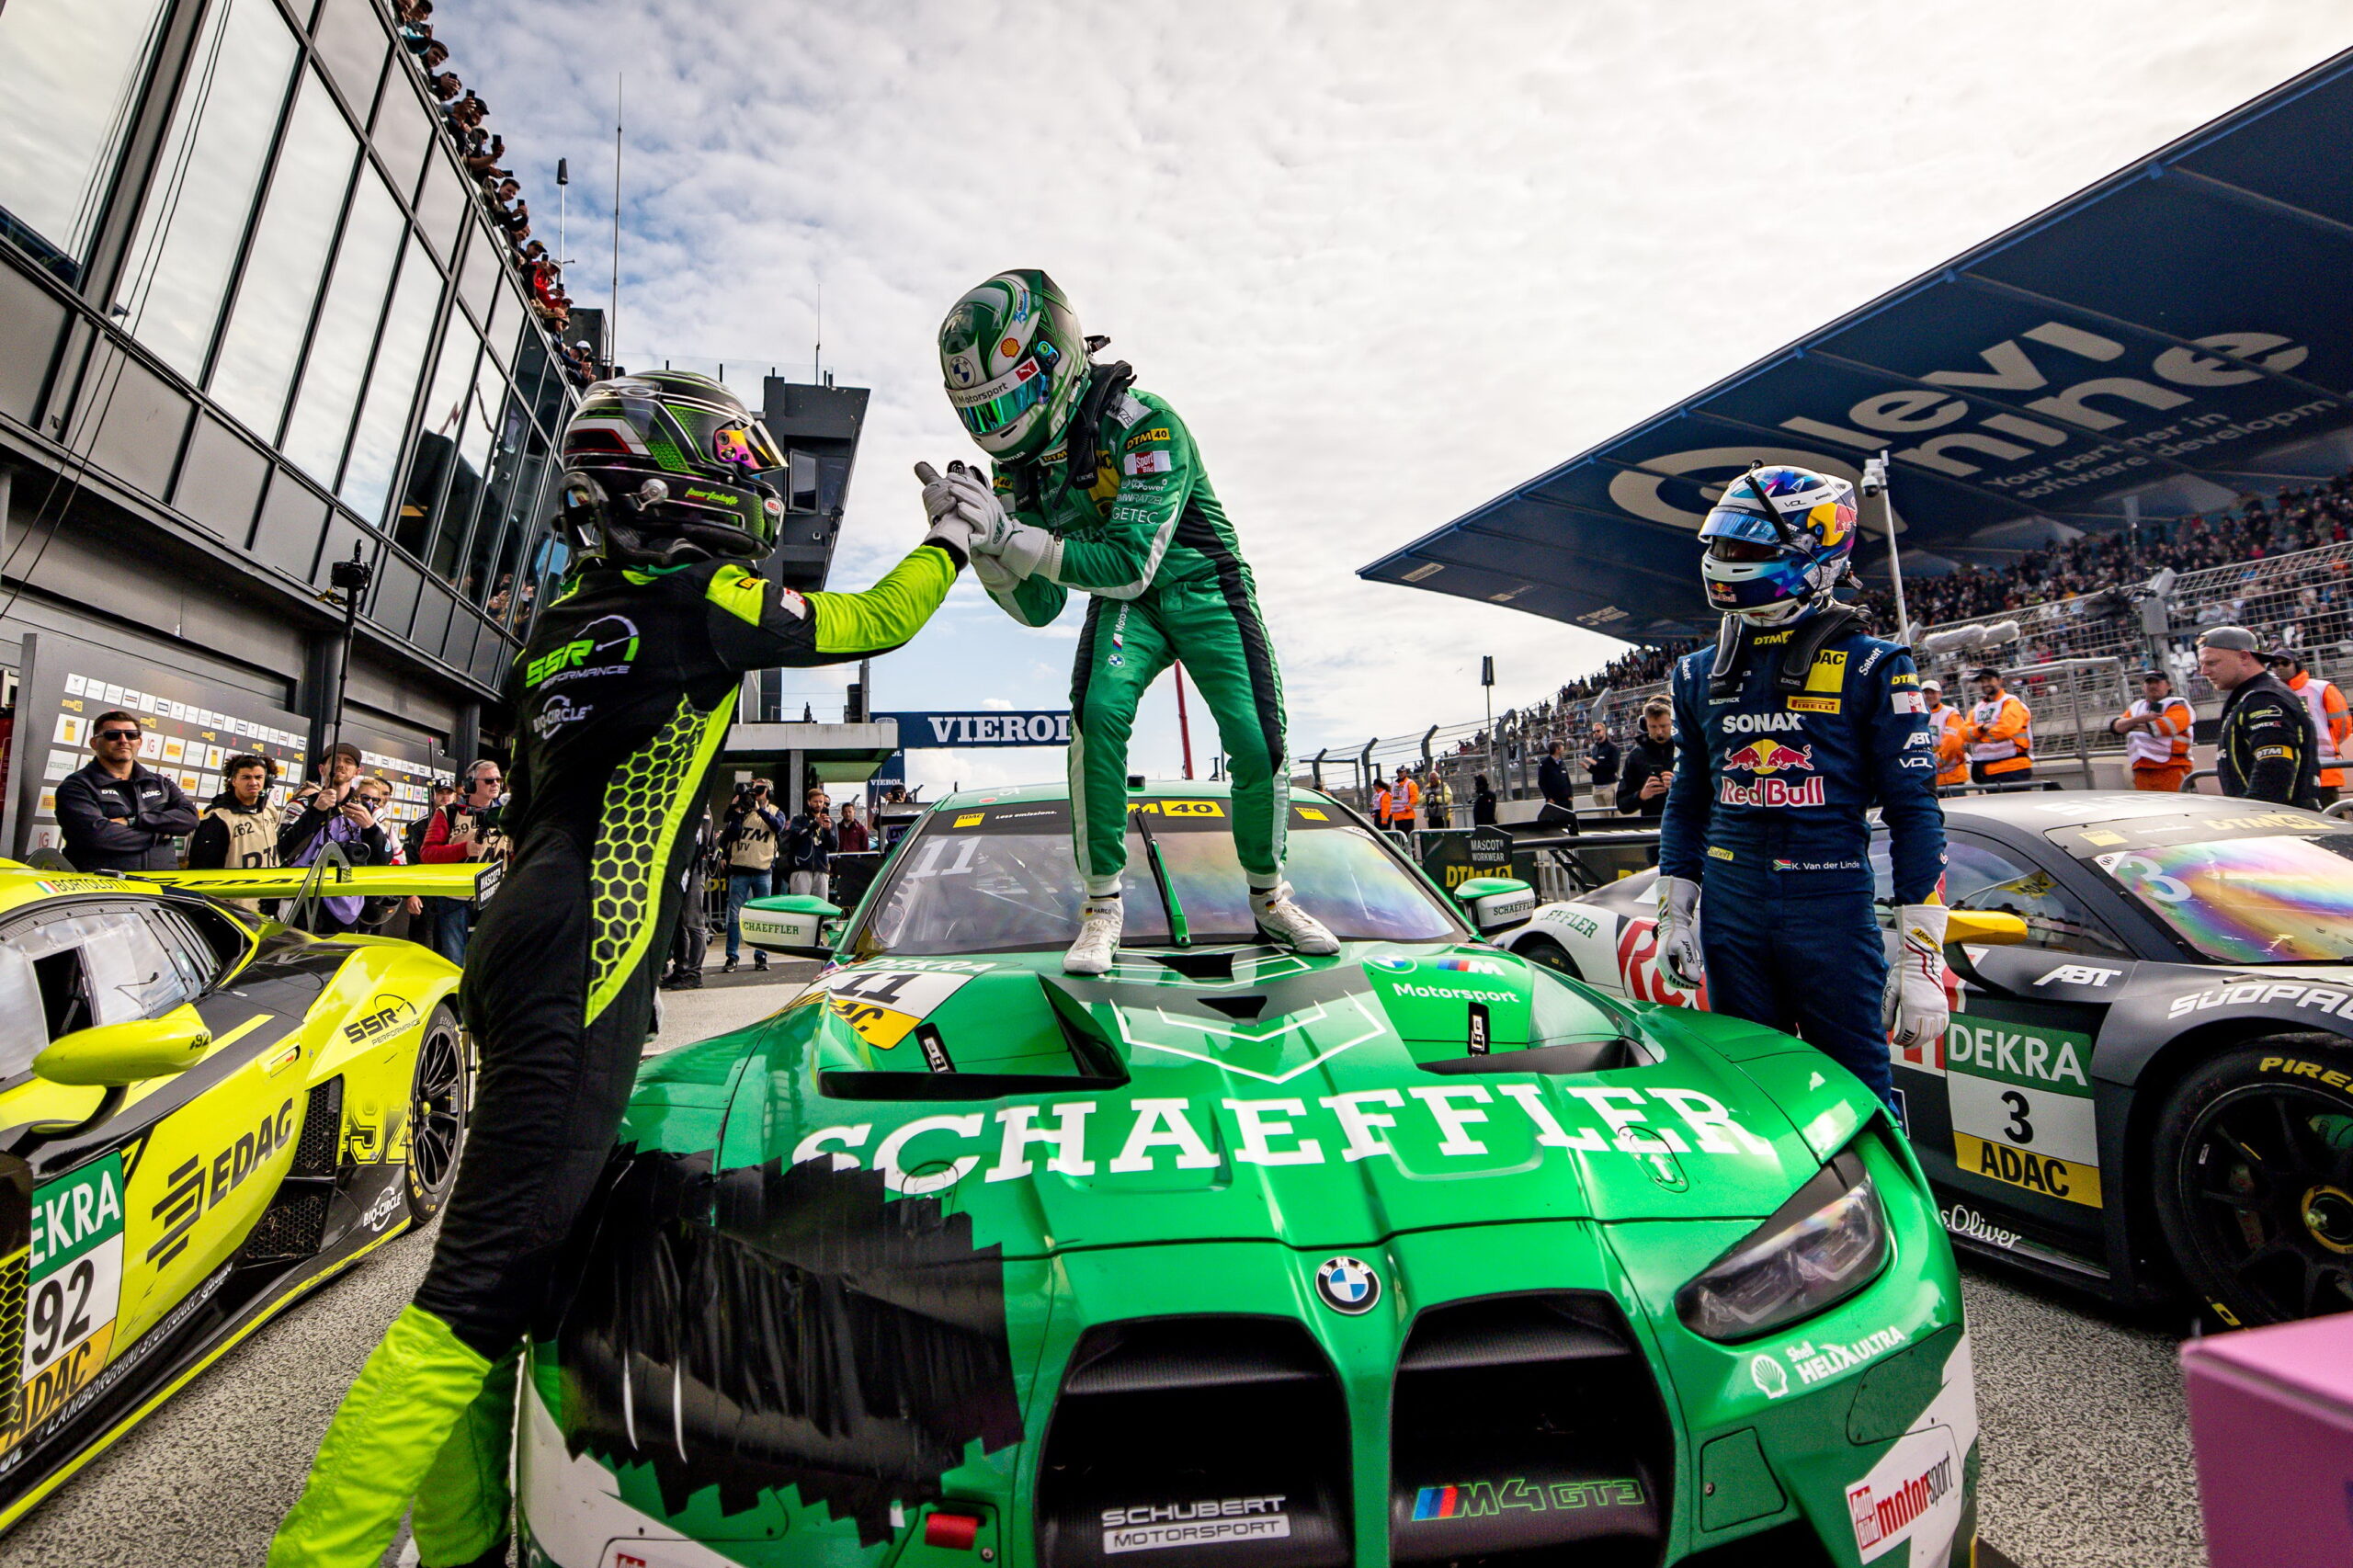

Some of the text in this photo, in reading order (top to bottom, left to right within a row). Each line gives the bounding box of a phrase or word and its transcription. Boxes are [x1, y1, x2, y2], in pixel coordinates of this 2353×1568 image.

[958, 381, 1008, 404] Motorsport
[1896, 333, 2310, 477] nine
[1127, 429, 1167, 450] DTM 40
[1982, 464, 2053, 489] Your
[2188, 411, 2232, 428] in
[1135, 452, 1154, 469] Sport
[1131, 483, 1165, 492] V-Power
[2017, 456, 2152, 499] software
[767, 501, 779, 511] BELL
[1112, 506, 1158, 525] GETEC
[1754, 634, 1782, 645] DTM
[526, 640, 595, 687] SSR
[1859, 647, 1884, 676] Sabelt
[1791, 699, 1836, 711] PIRELLI
[1722, 712, 1804, 734] SONAX
[142, 790, 163, 800] ADAC
[1721, 776, 1825, 807] Red Bull
[959, 812, 984, 821] ADAC
[1171, 803, 1213, 814] 40
[905, 835, 983, 876] 11
[1472, 852, 1505, 862] WORKWEAR
[1792, 862, 1802, 870] K.
[1823, 860, 1838, 869] der
[1840, 859, 1860, 869] Linde
[54, 878, 131, 892] BORTOLOTTI
[2118, 855, 2193, 903] 3
[1493, 899, 1536, 916] SCHAEFFLE
[743, 921, 800, 936] CHAEFFLER
[1544, 910, 1599, 939] EFFLER
[852, 958, 998, 972] DEKRA
[2032, 963, 2123, 987] ABT
[829, 971, 922, 1005] 11
[1392, 983, 1520, 1003] Motorsport
[343, 1007, 399, 1044] SSR
[371, 1017, 421, 1046] PERFORMANCE
[189, 1031, 210, 1051] #92
[1949, 1022, 2088, 1087] DEKRA
[2001, 1090, 2034, 1145] 3
[792, 1084, 1774, 1194] SCHAEFFLER
[208, 1097, 293, 1211] EDAG
[1981, 1141, 2070, 1198] ADAC
[29, 1170, 121, 1270] EKRA
[363, 1193, 403, 1228] BIO-CIRCLE
[1940, 1203, 2022, 1249] s.Oliver
[31, 1258, 95, 1368] 92
[1786, 1340, 1816, 1363] Shell
[1794, 1325, 1906, 1385] HELIX ULTRA
[5, 1341, 91, 1449] ADAC
[46, 1346, 140, 1436] LAMBORGHINI
[1549, 1479, 1645, 1510] GT3
[1876, 1449, 1954, 1539] motorsport
[1101, 1495, 1287, 1528] SCHUBERT
[1114, 1519, 1280, 1549] MOTORSPORT
